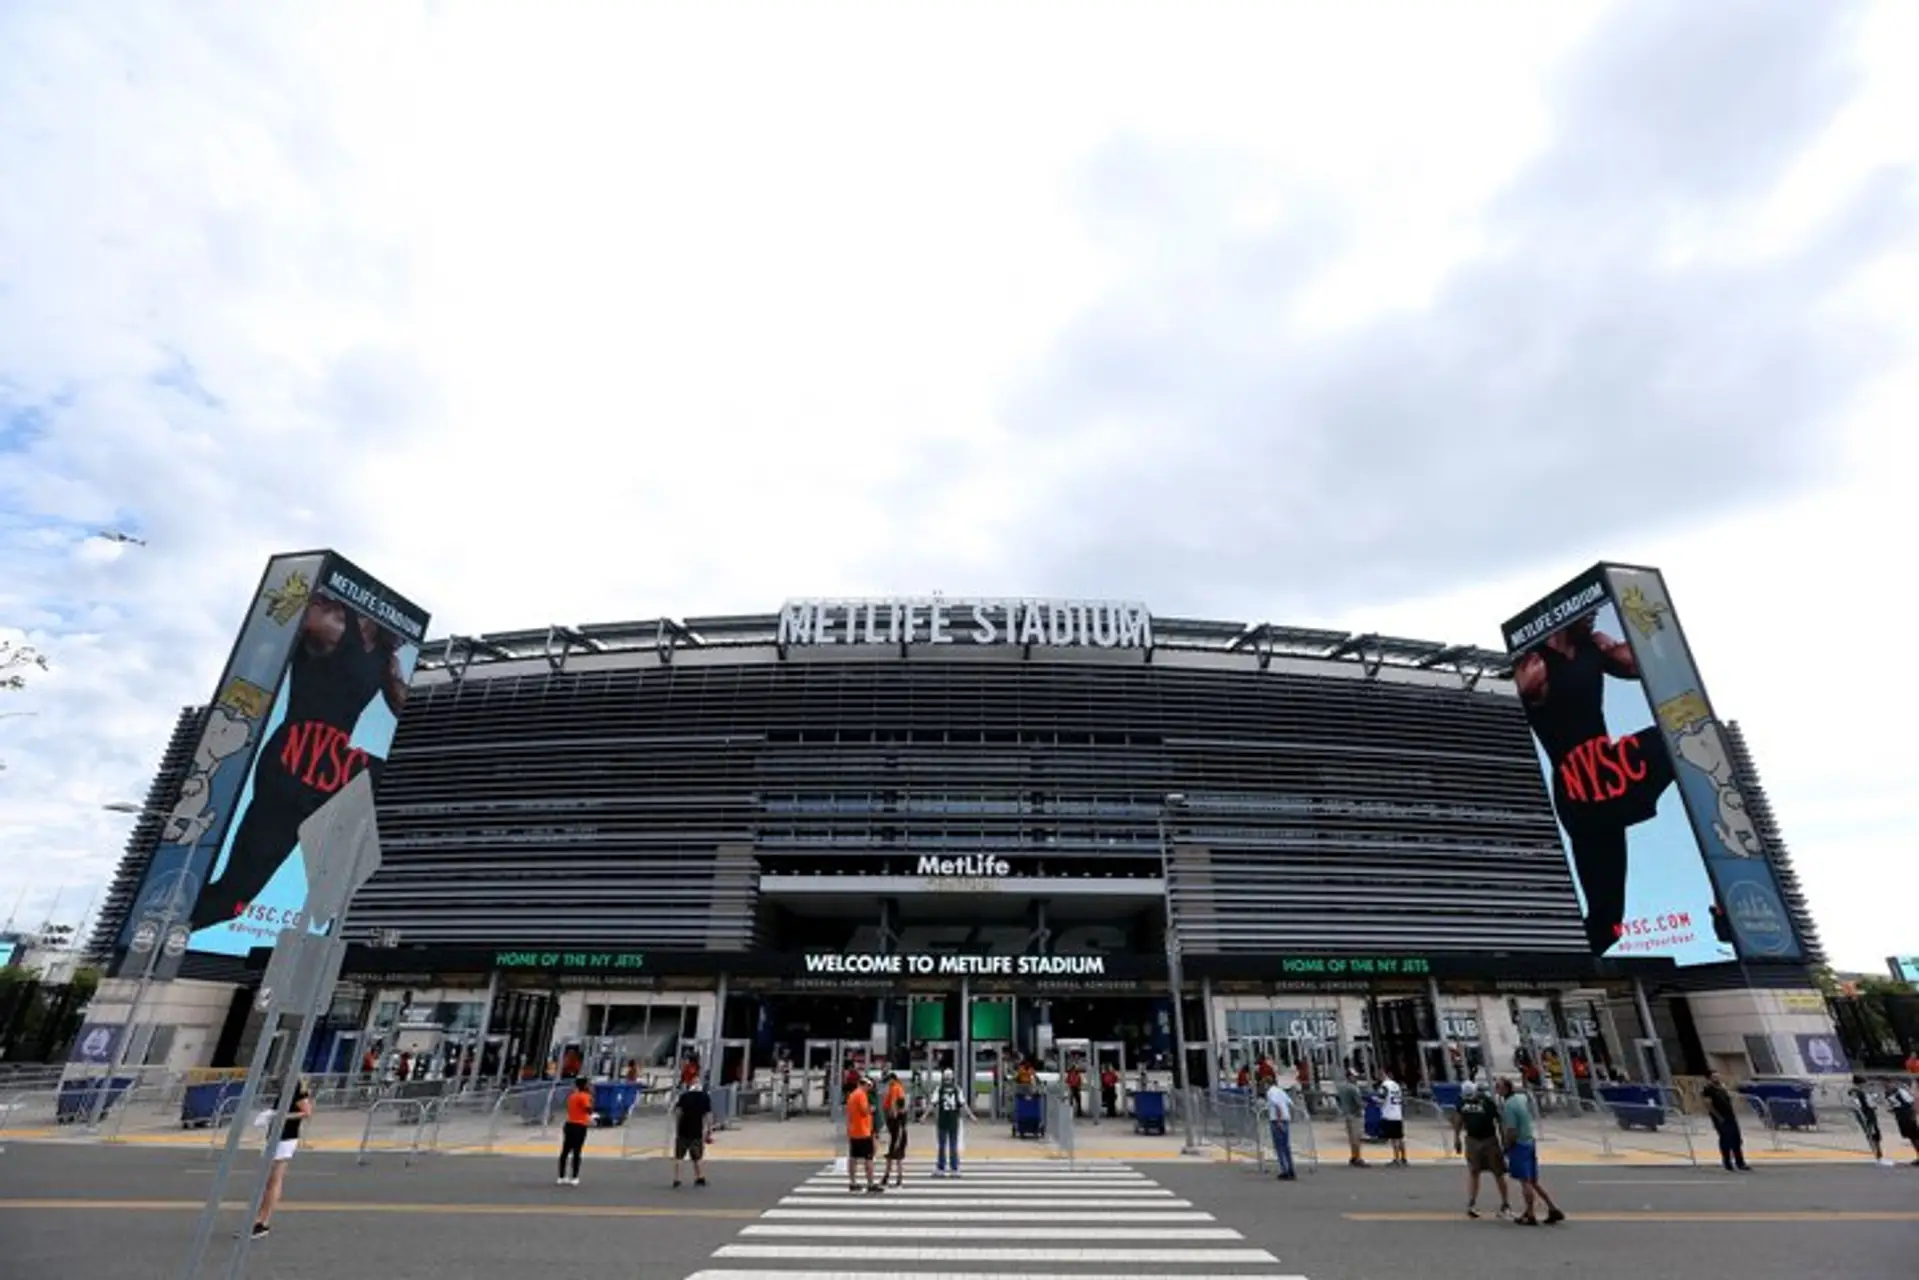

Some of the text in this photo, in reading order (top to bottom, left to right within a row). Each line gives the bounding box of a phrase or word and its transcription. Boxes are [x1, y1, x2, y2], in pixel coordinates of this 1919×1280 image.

[329, 570, 377, 612] METLIFE
[778, 599, 1153, 648] METLIFE STADIUM
[1511, 582, 1604, 647] METLIFE STADIUM
[1560, 735, 1647, 802] NYSC
[917, 854, 1010, 875] MetLife
[496, 952, 645, 968] HOME OF THE NY JETS
[805, 954, 1105, 975] WELCOME TO METLIFE STADIUM
[1282, 958, 1430, 973] HOME OF THE NY JETS
